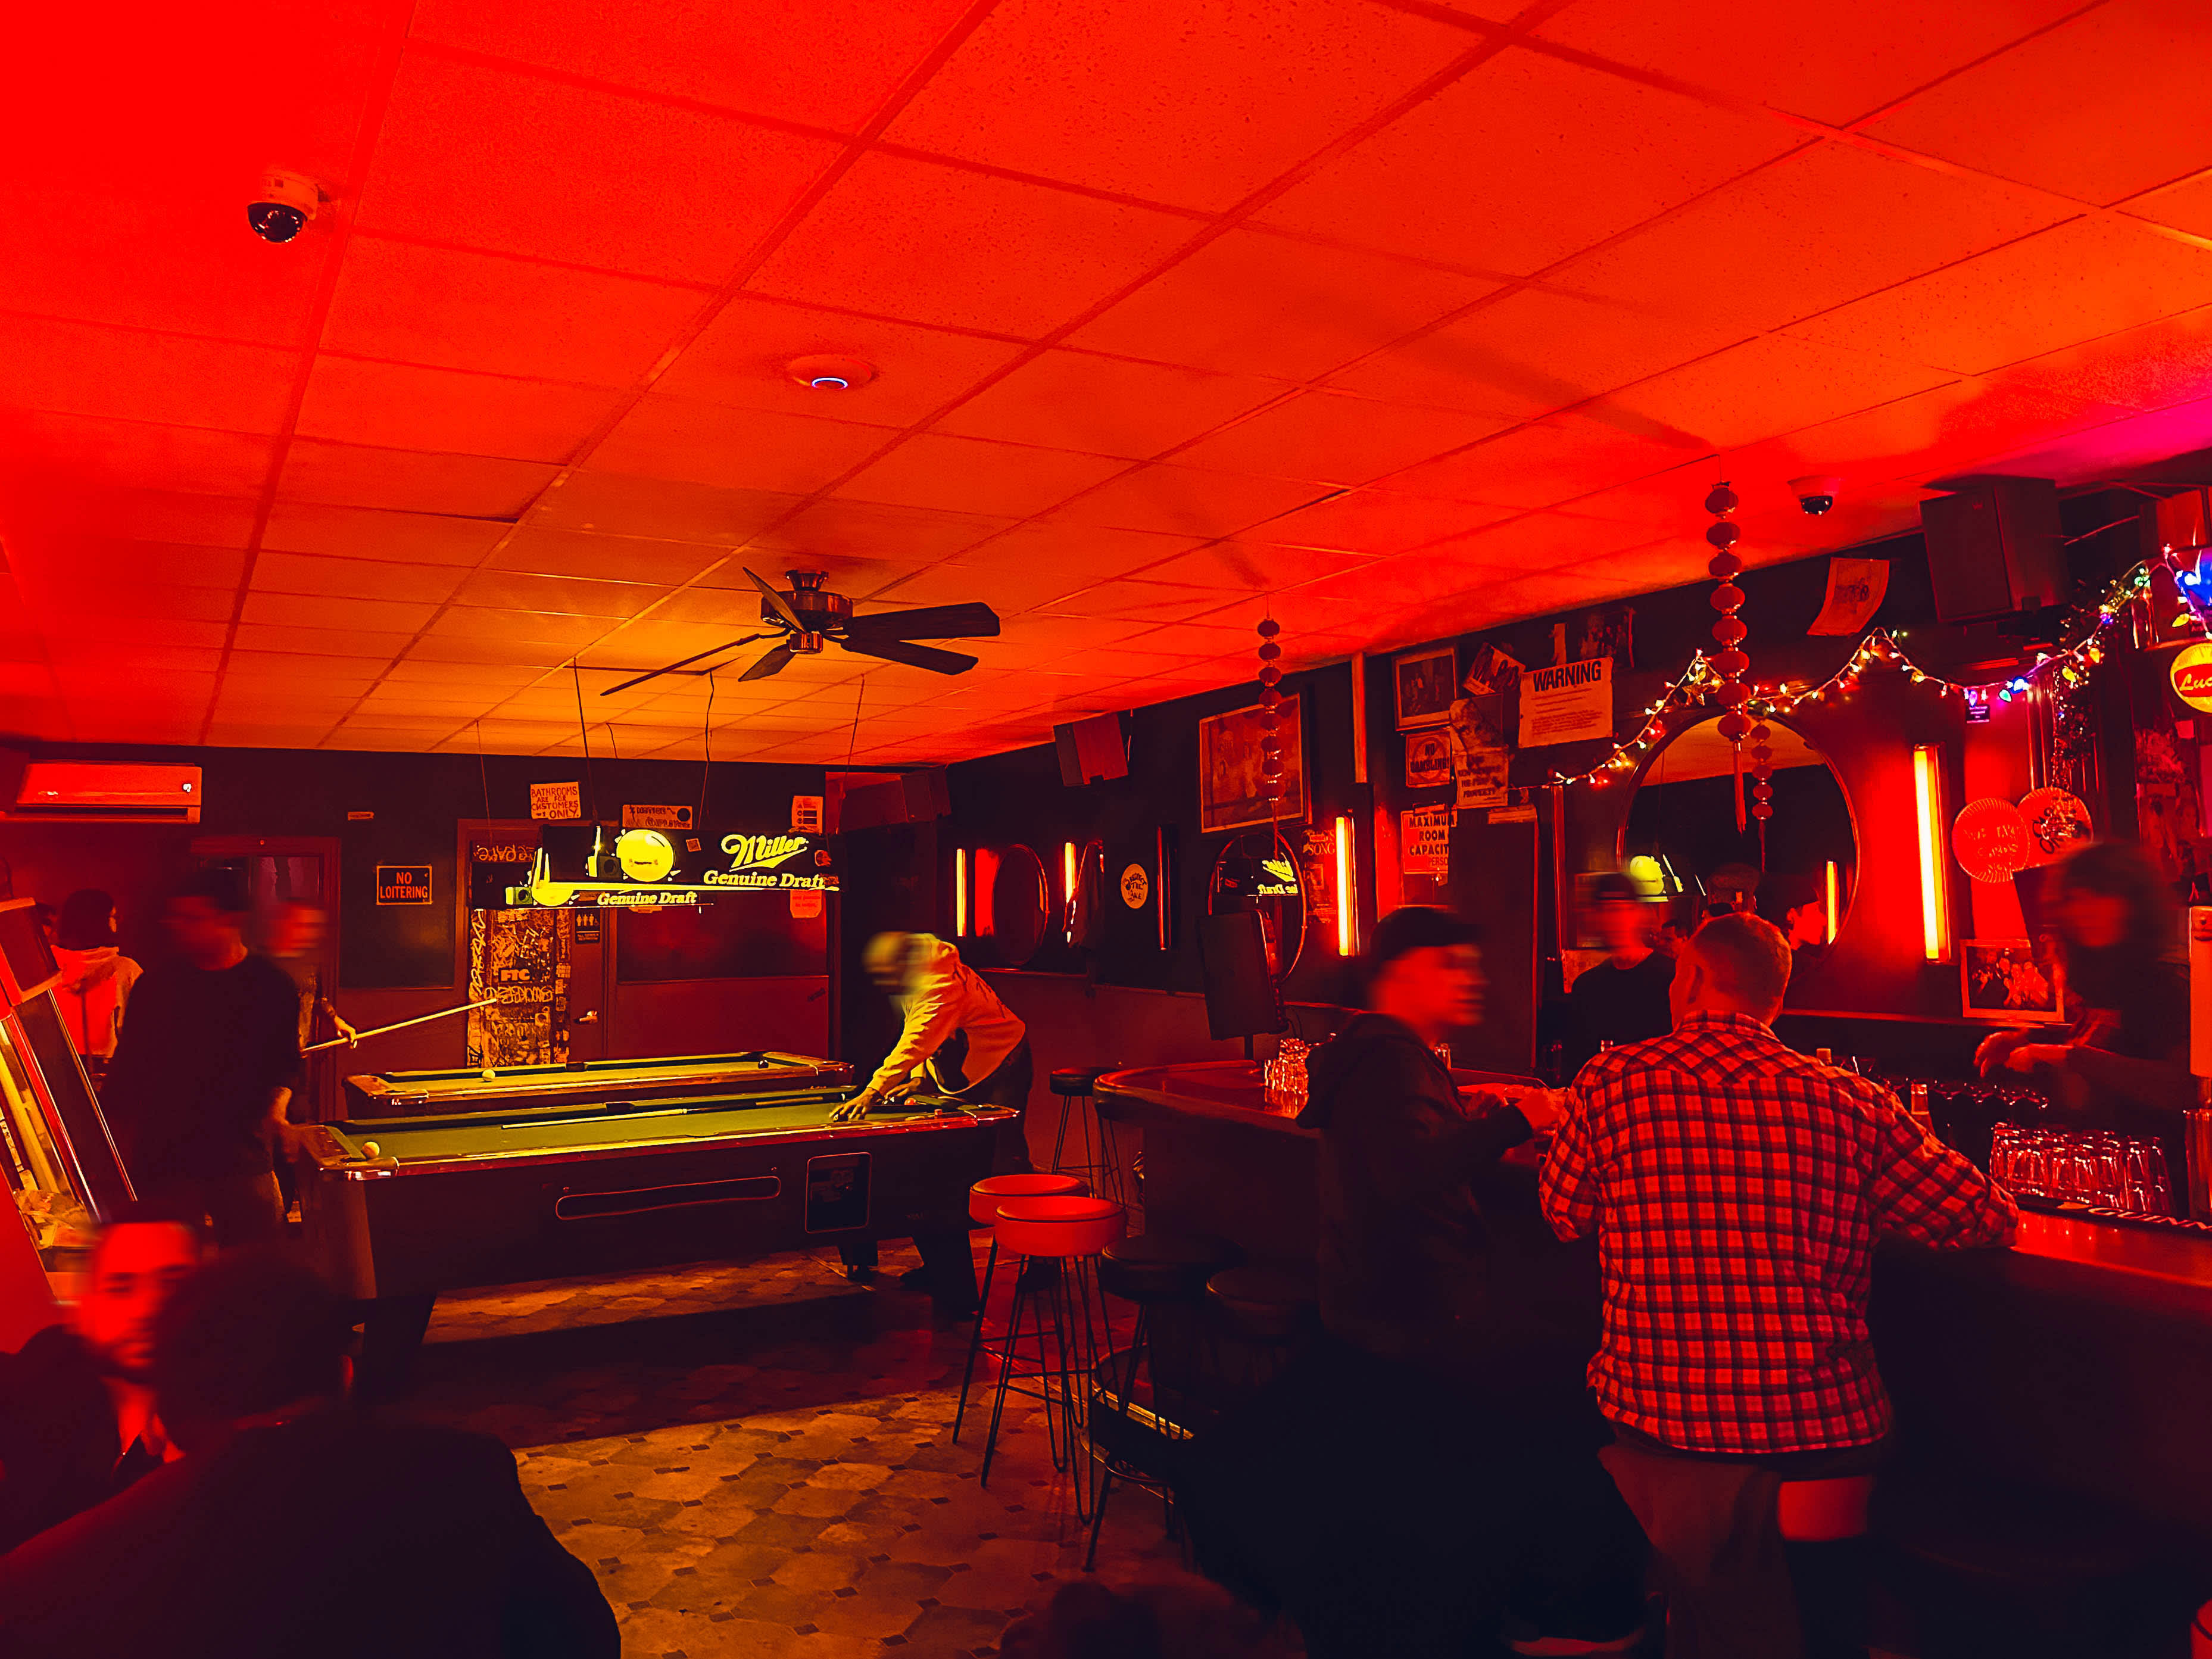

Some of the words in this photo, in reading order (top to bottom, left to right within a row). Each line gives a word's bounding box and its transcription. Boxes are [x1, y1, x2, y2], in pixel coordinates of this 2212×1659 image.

[1533, 660, 1601, 692] WARNING
[1425, 743, 1435, 756] NO
[1410, 757, 1449, 774] GAMBLING!
[532, 786, 578, 798] BATHROOMS
[532, 800, 579, 811] CUSTOMERS
[1419, 830, 1445, 841] ROOM
[721, 834, 809, 871] Miller
[1309, 842, 1335, 856] SONG
[396, 872, 412, 884] NO
[704, 870, 778, 886] Genuine
[779, 873, 825, 888] Draft
[380, 885, 428, 899] LOITERING
[597, 891, 657, 906] Genuine
[659, 891, 698, 905] Draft
[500, 969, 531, 982] FTC
